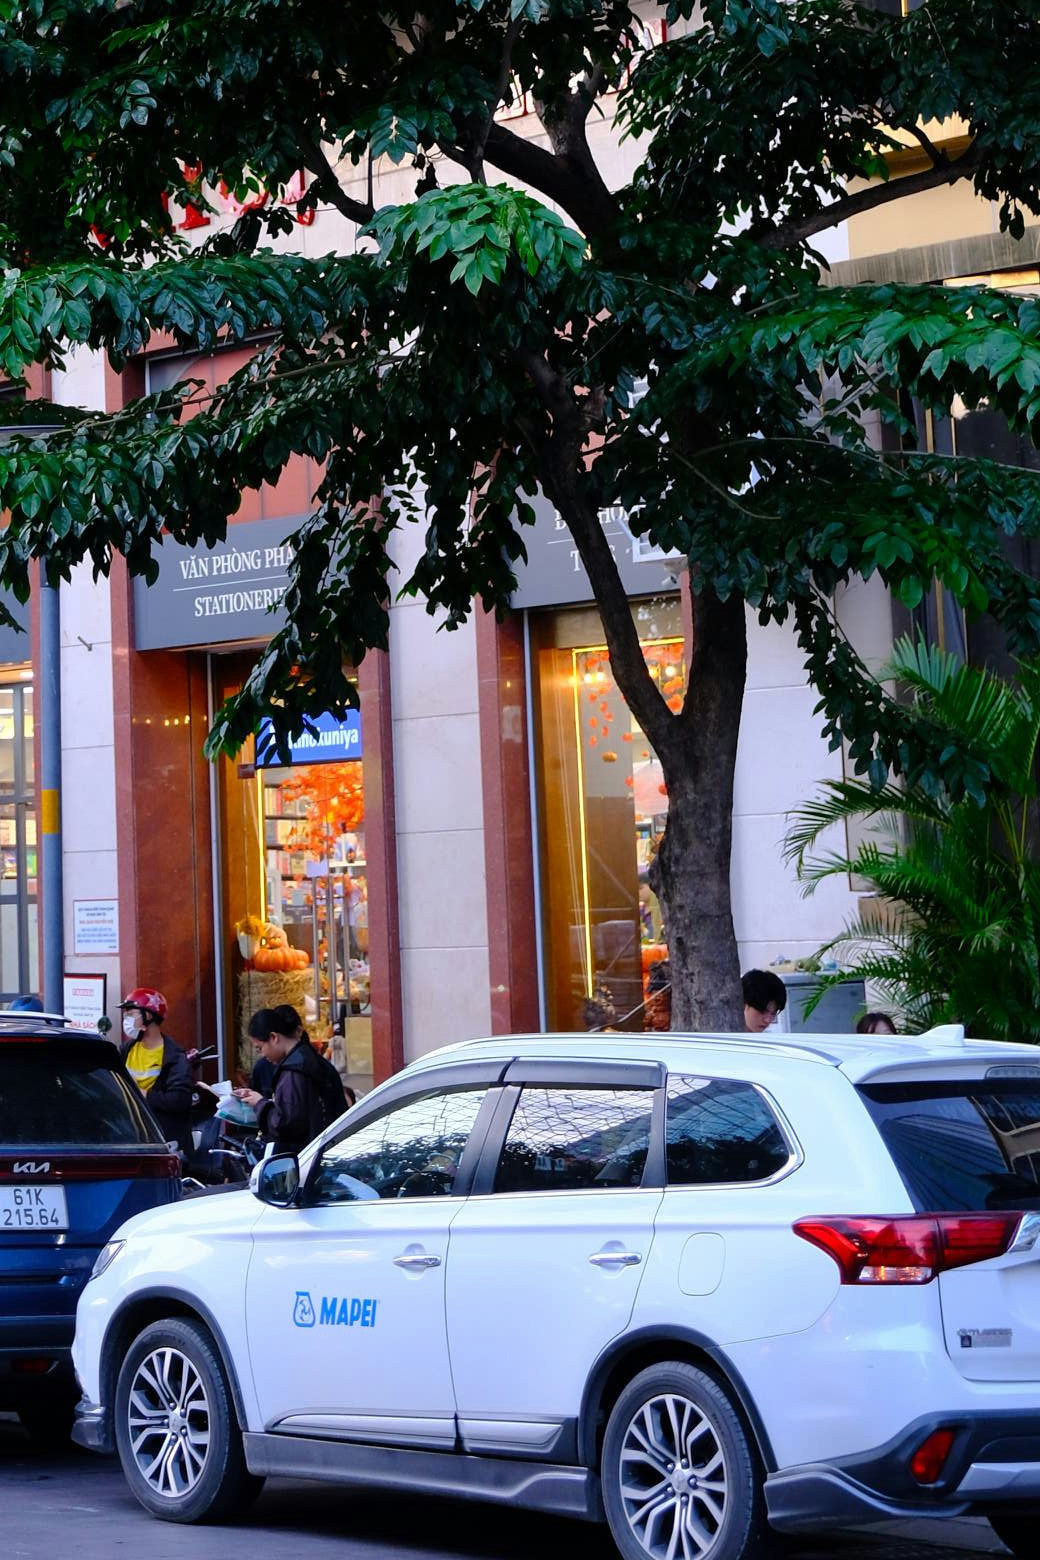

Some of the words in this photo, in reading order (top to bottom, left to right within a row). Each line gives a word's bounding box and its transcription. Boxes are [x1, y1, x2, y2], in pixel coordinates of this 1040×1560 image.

[180, 555, 209, 579] VĂN
[212, 548, 261, 575] PHÒNG
[195, 587, 287, 617] STATIONERIE
[13, 1189, 44, 1206] 61K
[3, 1208, 60, 1226] 215.64
[320, 1296, 377, 1327] MAPEI
